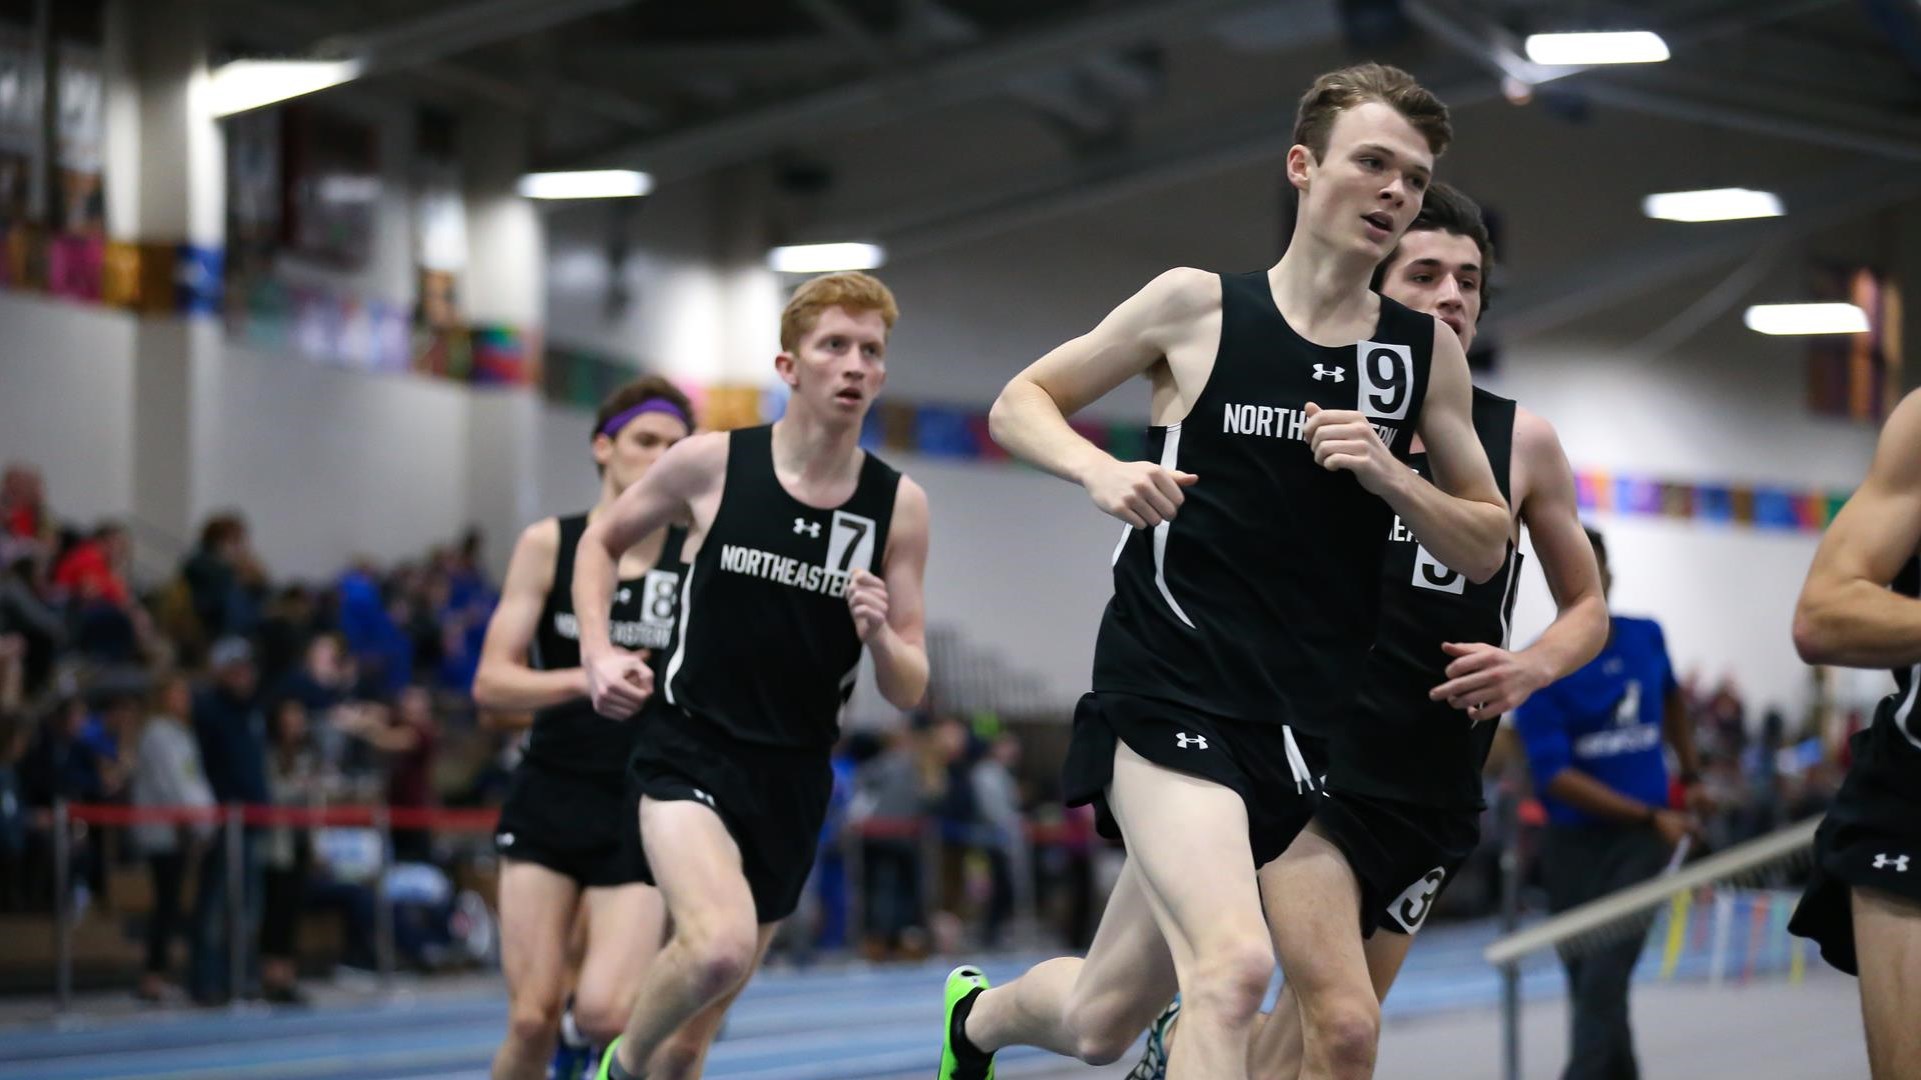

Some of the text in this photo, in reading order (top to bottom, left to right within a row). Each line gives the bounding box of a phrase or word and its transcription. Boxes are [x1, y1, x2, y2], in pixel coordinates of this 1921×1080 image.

[1366, 348, 1407, 414] 9
[838, 518, 867, 572] 7
[652, 580, 677, 619] 8
[1400, 870, 1443, 927] 3
